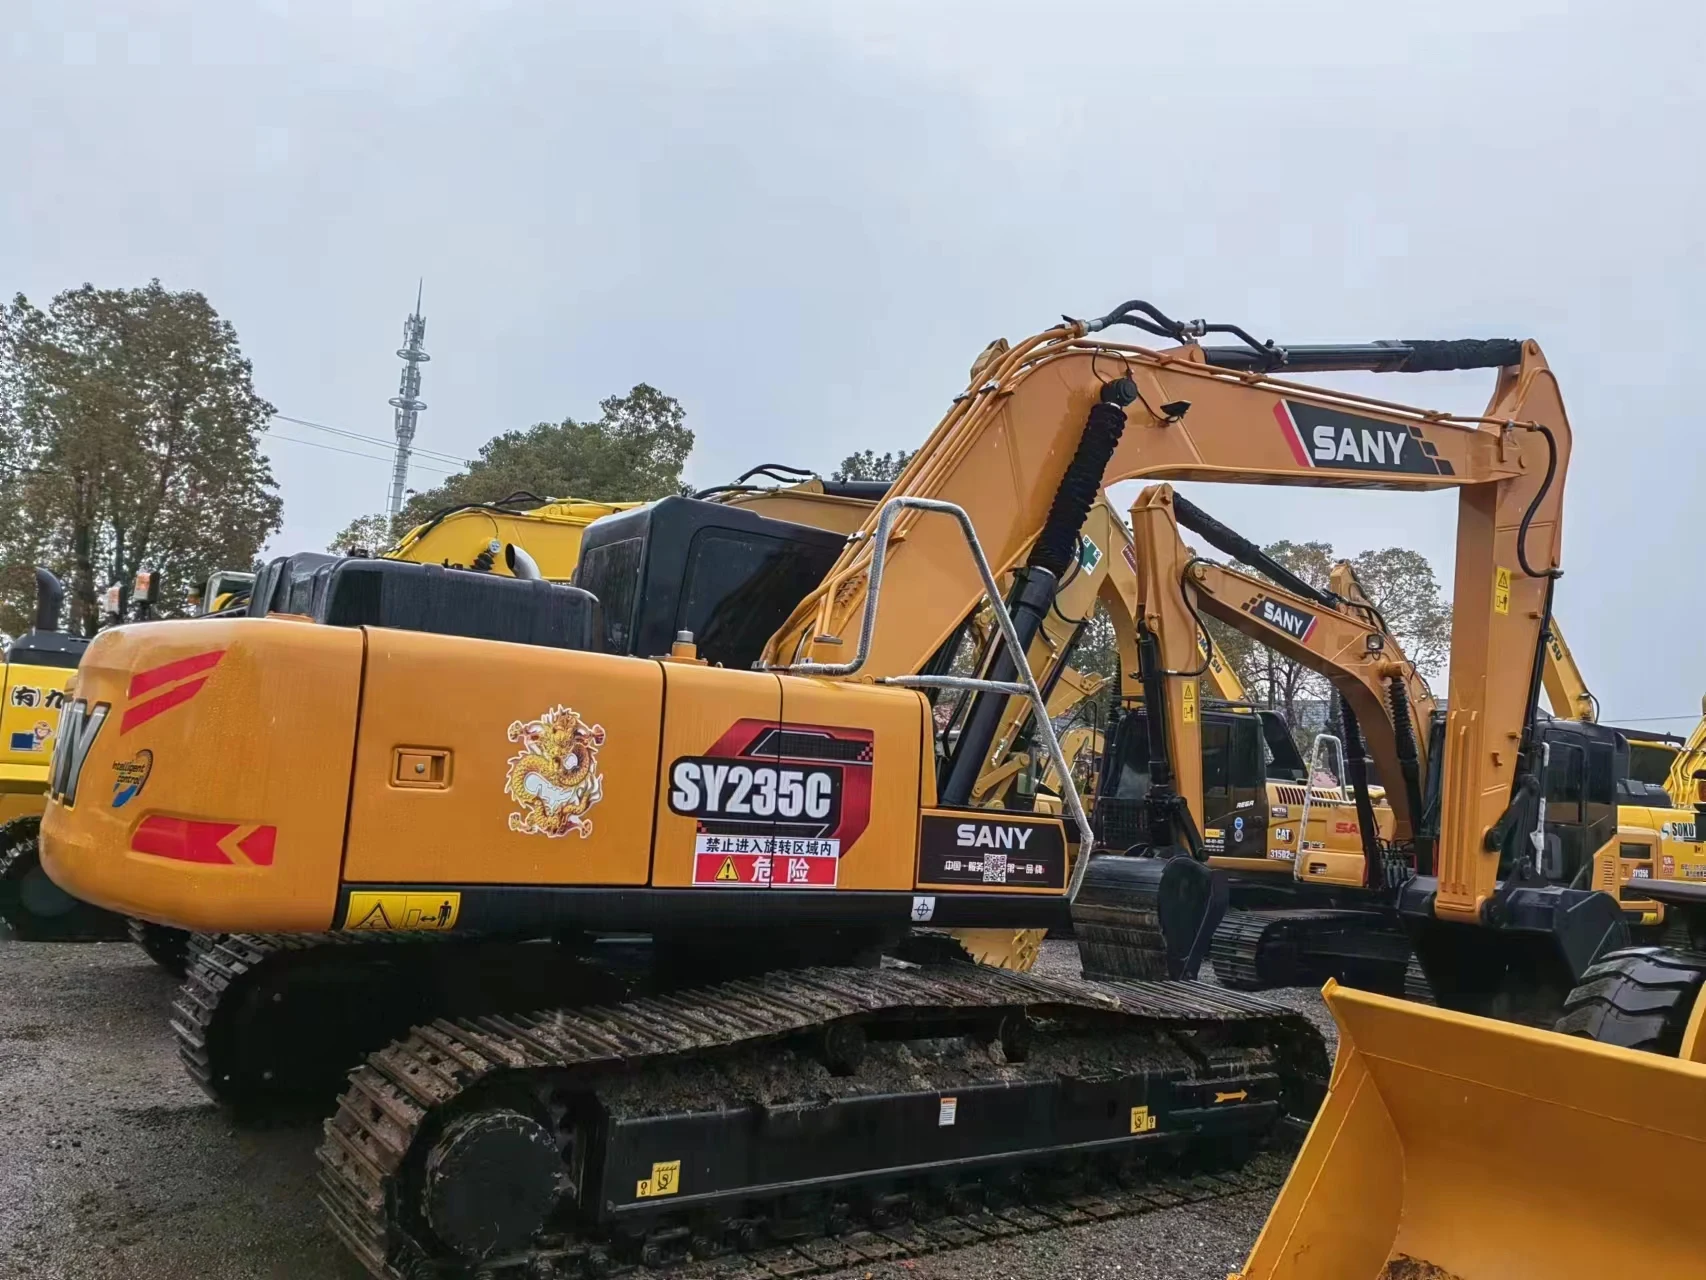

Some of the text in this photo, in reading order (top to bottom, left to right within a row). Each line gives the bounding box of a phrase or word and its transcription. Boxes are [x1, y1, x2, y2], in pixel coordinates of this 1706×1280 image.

[1313, 425, 1407, 464] SANY
[1263, 601, 1304, 635] SANY
[672, 762, 832, 819] SY235C
[706, 837, 832, 856] 禁止进入旋转区域内
[956, 824, 1033, 850] SANY
[1275, 828, 1291, 841] CAT
[751, 856, 811, 883] 危险
